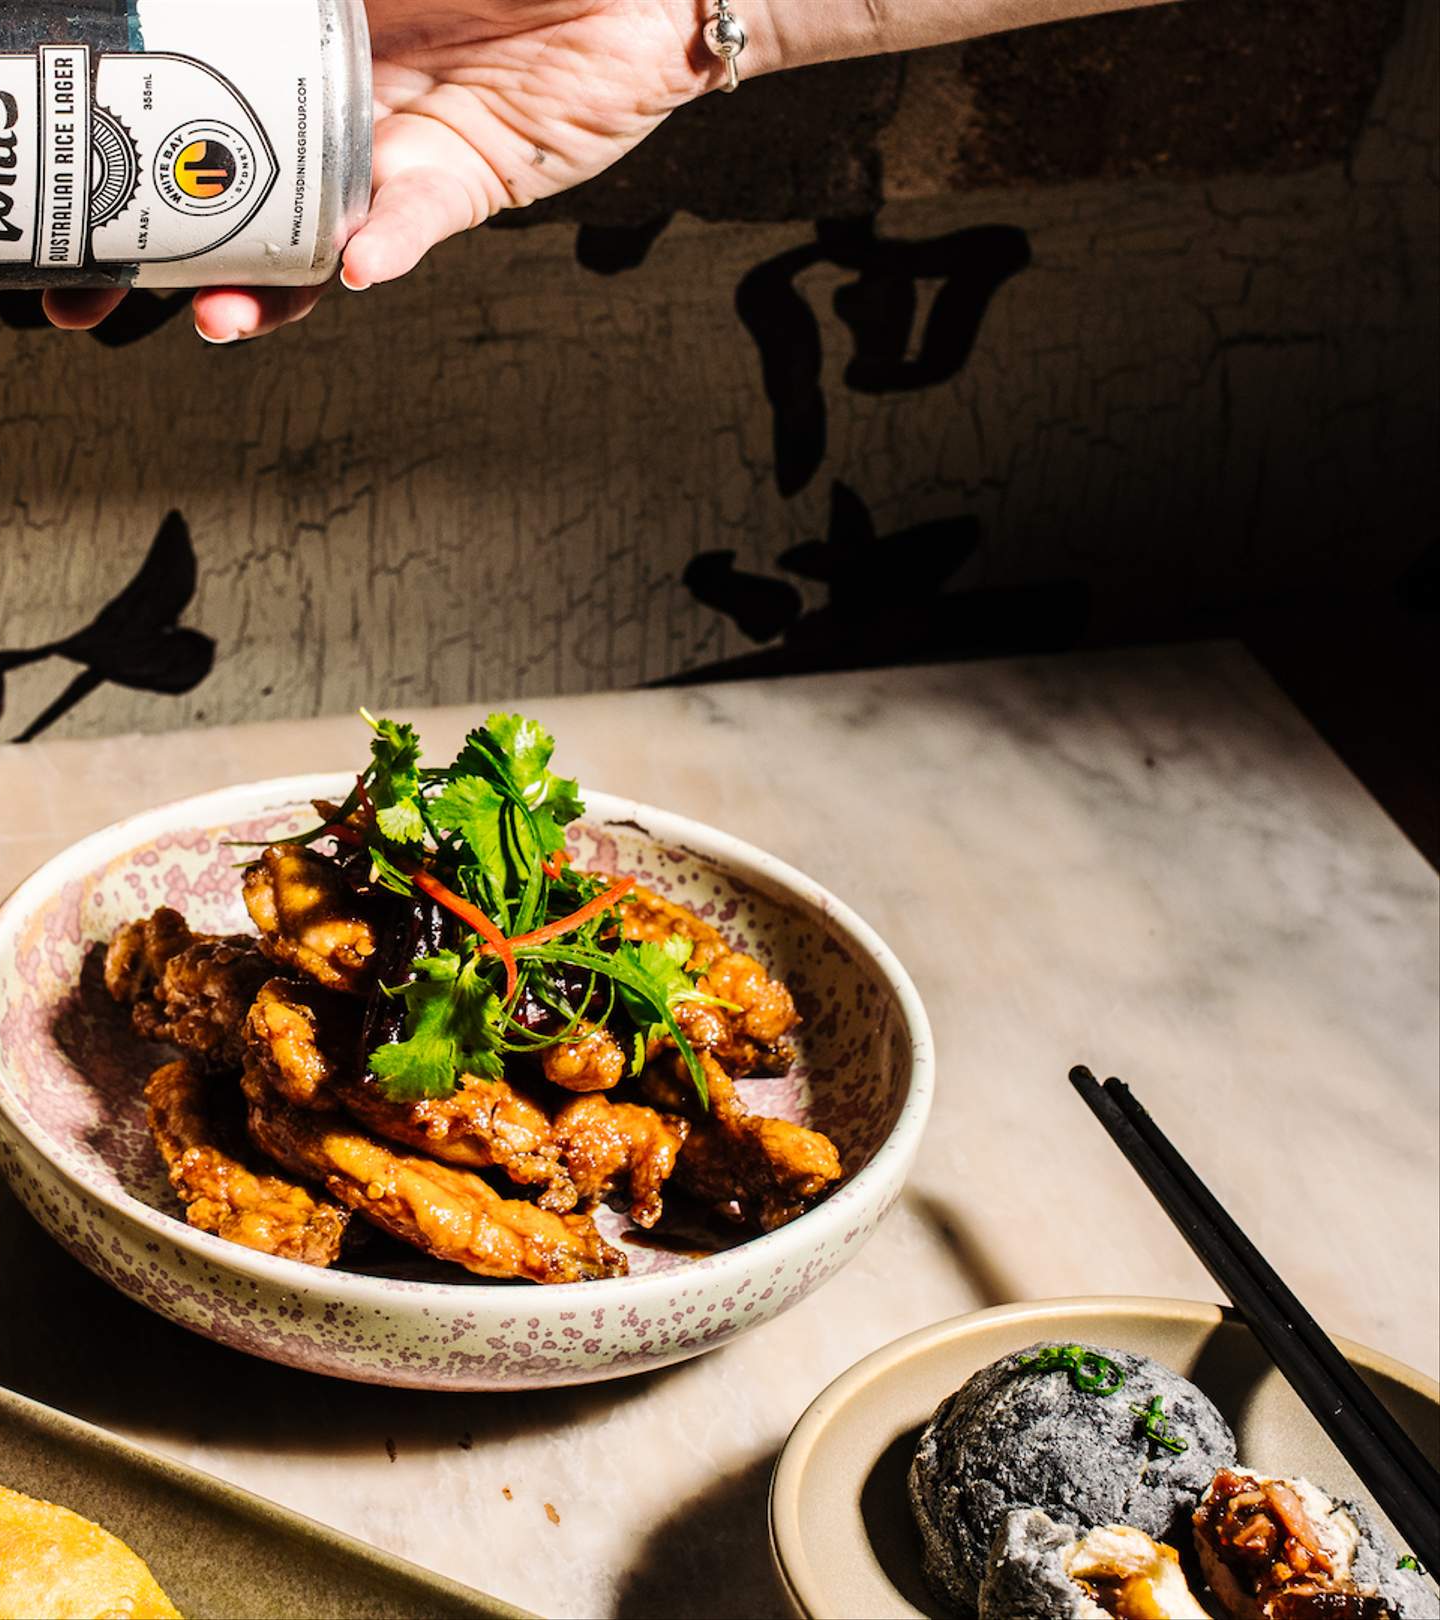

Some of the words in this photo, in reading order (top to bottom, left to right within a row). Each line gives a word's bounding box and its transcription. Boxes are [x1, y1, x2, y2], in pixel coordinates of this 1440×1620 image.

[54, 57, 74, 115] LAGER
[143, 74, 153, 111] 355mL
[54, 123, 74, 165] RICE
[162, 134, 184, 160] BAY
[290, 76, 307, 247] WWW.LOTUSDININGGROUP.COM
[159, 162, 182, 204] WHITE
[235, 146, 249, 194] SYDNEY
[48, 171, 74, 262] AUSTRALIAN
